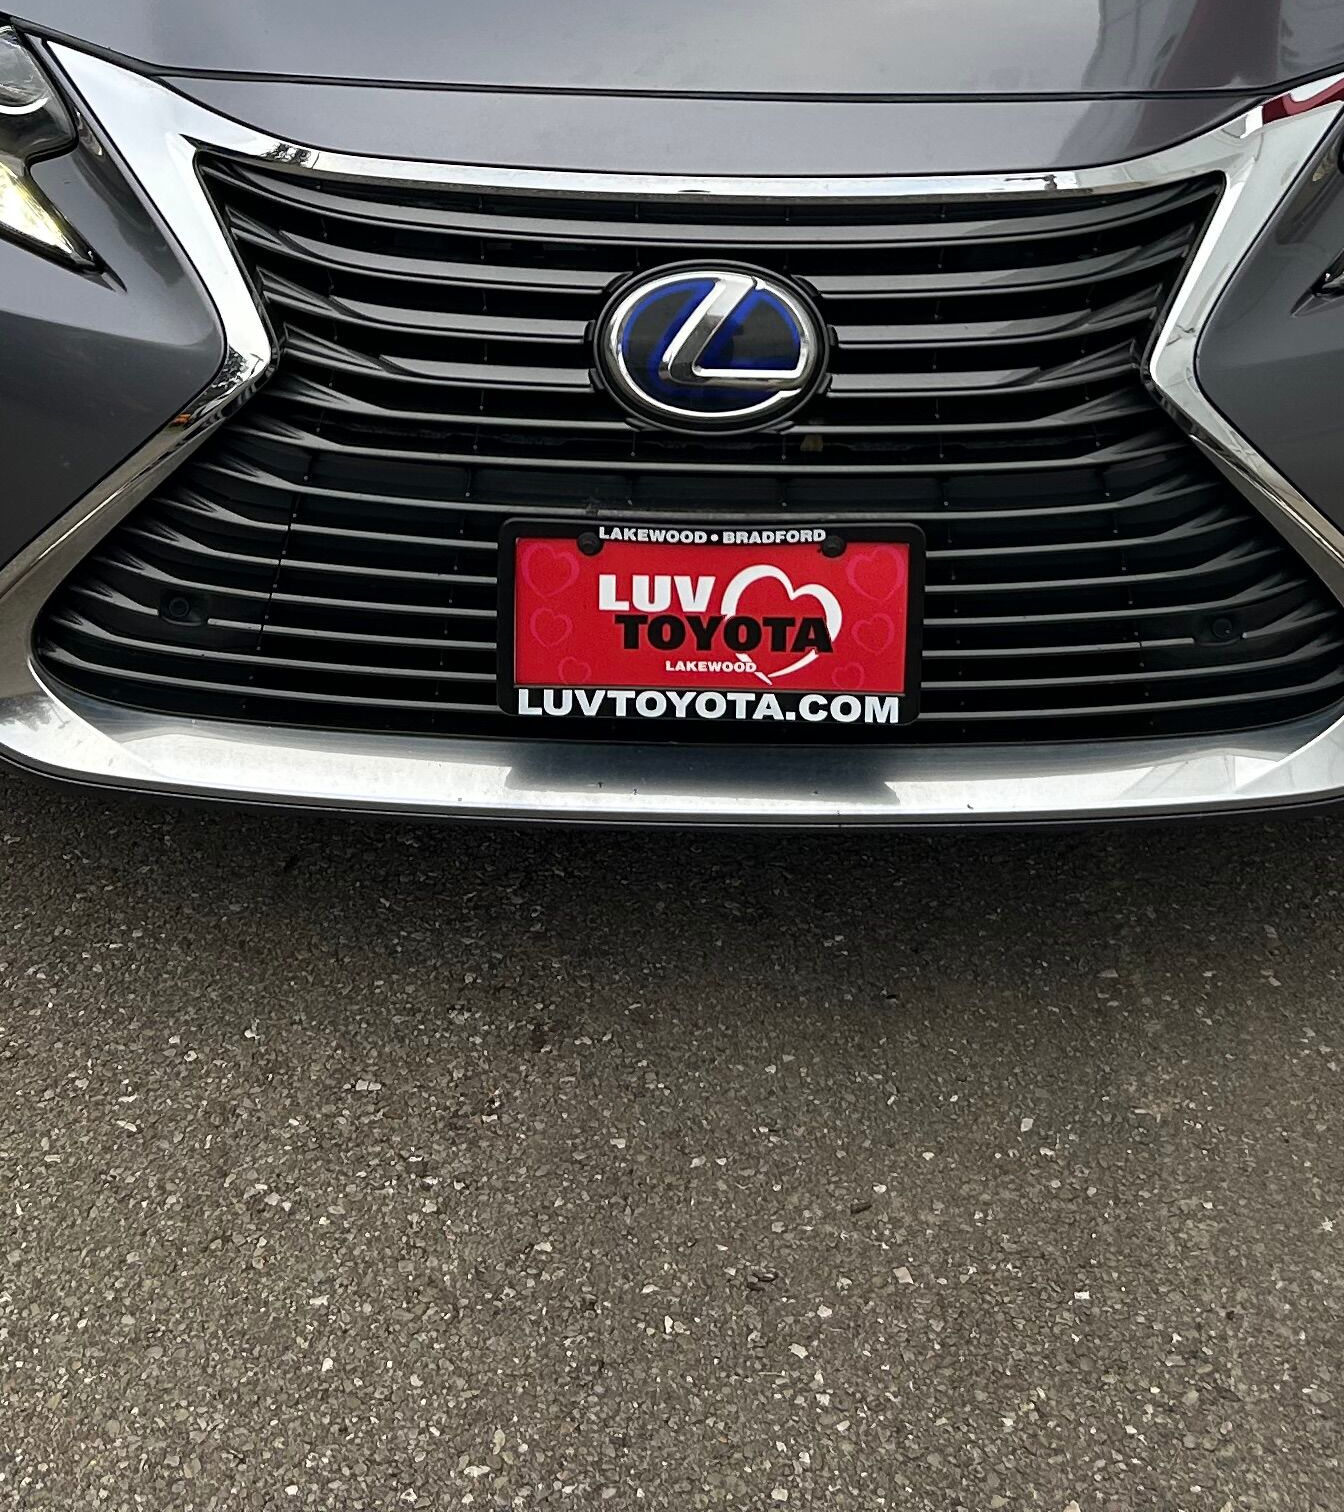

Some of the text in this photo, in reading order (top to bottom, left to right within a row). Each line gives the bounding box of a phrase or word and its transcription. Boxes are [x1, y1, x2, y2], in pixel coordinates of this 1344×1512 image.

[598, 526, 827, 545] LAKEWOOD BRADFORD
[598, 574, 716, 613] LUV
[614, 613, 834, 654] TOYOTA
[665, 660, 757, 673] LAKEWOOD
[518, 688, 899, 724] LUVTOYOTA.COM
